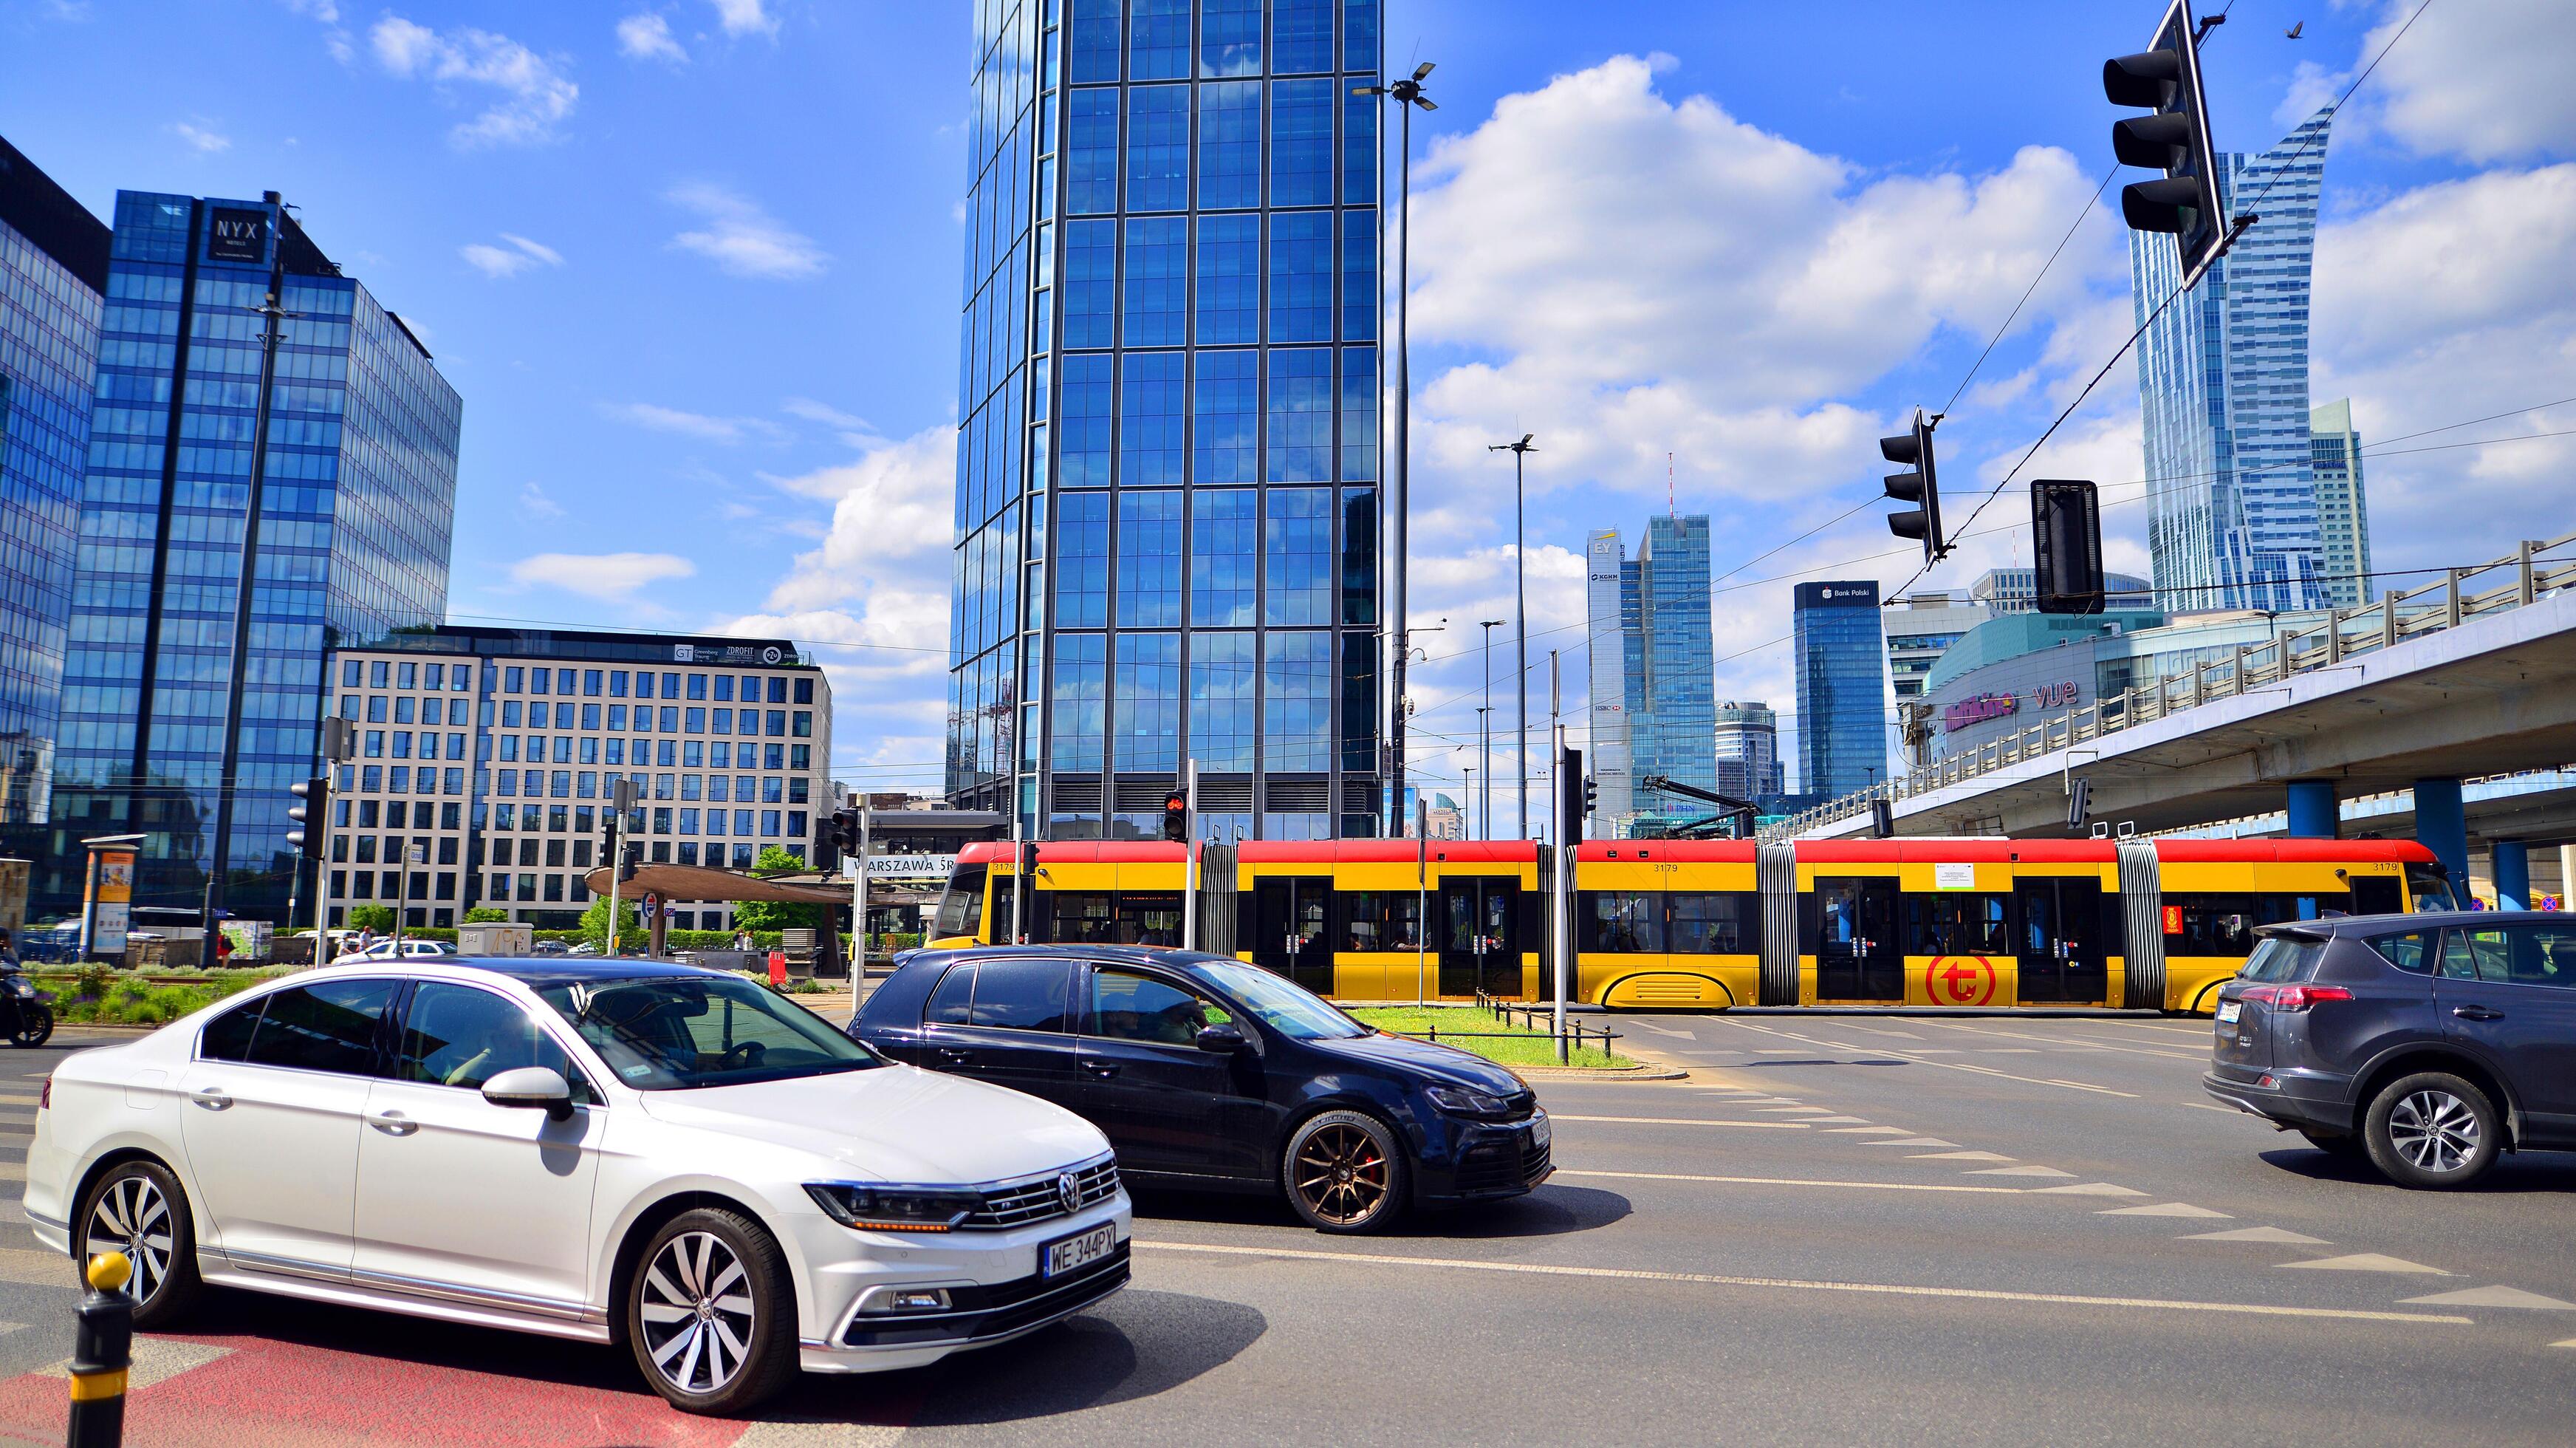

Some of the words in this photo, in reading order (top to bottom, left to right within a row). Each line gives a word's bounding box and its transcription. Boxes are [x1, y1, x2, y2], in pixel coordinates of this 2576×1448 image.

[217, 220, 257, 239] NYX
[1594, 543, 1611, 553] EY
[676, 648, 692, 658] GT
[727, 646, 754, 655] ZDROFIT
[2032, 680, 2077, 708] vue
[993, 863, 1015, 871] 3179
[2373, 863, 2397, 871] 3179
[1052, 1243, 1072, 1272] WE
[1077, 1227, 1113, 1263] 344PX
